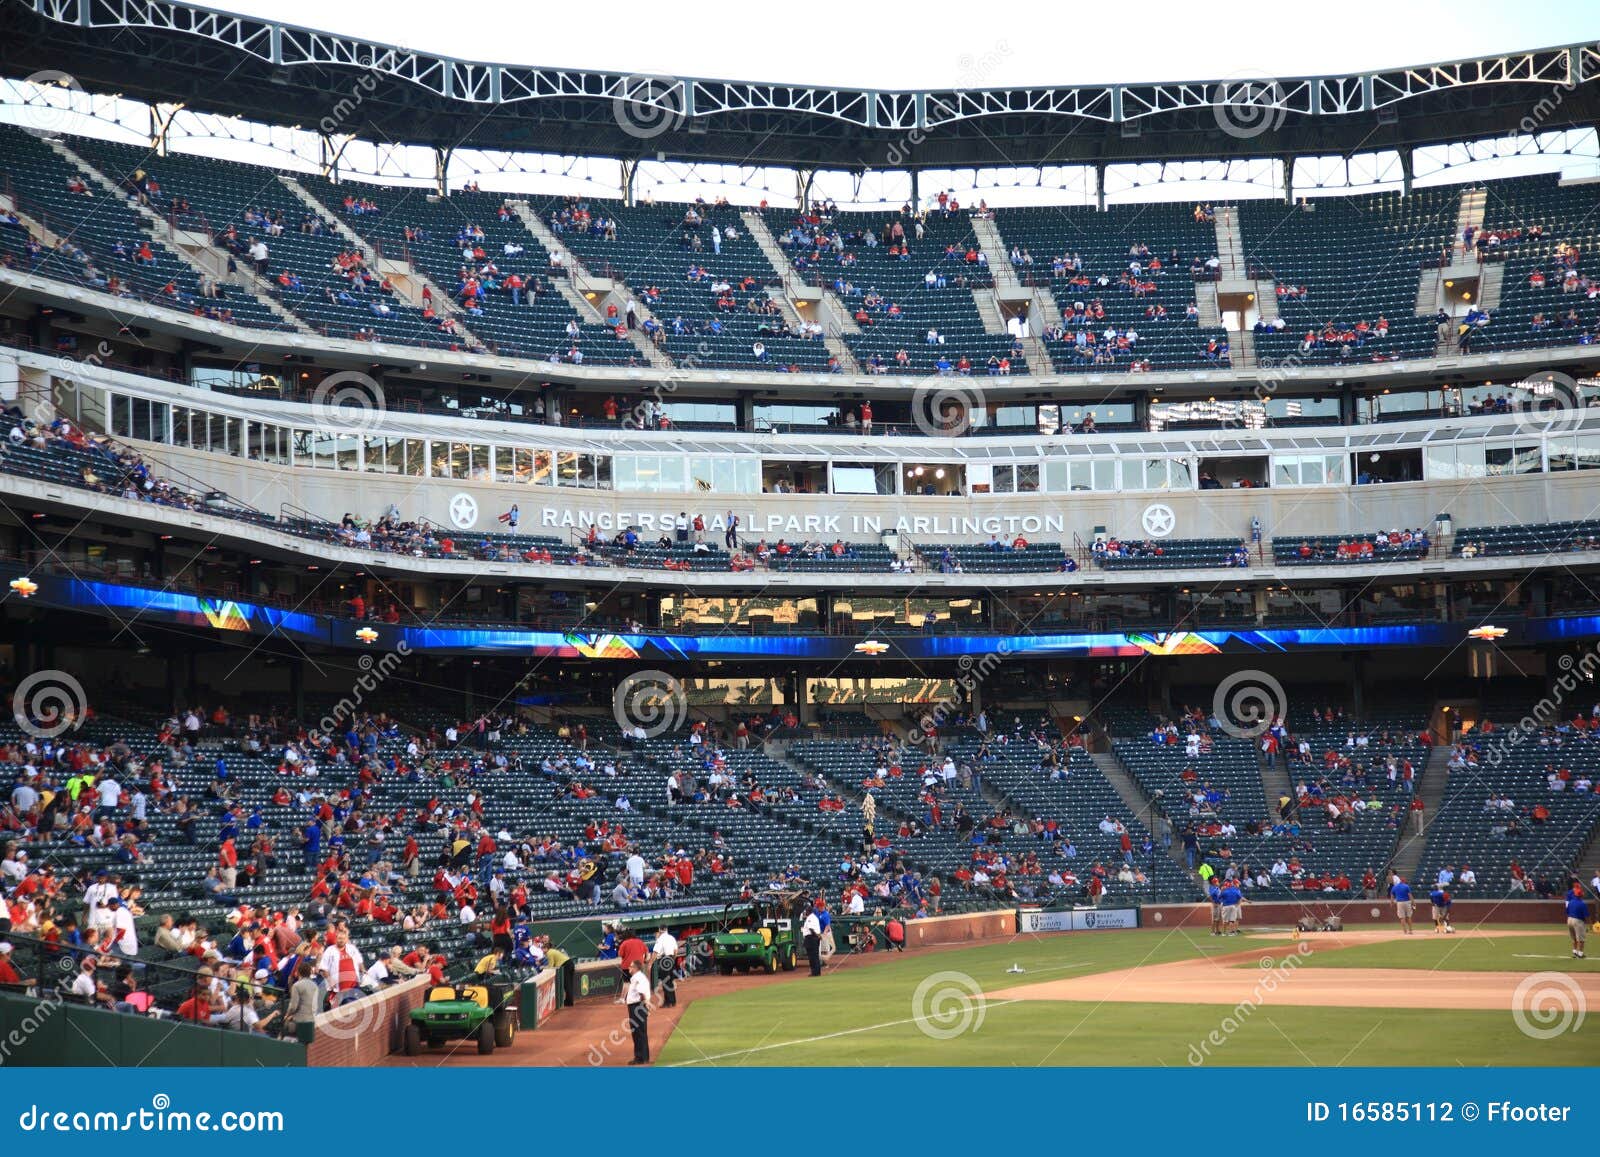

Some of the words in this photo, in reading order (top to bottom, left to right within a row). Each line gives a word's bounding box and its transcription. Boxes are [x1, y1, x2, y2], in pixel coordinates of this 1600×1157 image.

[542, 508, 677, 532] RANGERS
[852, 515, 881, 533] IN
[896, 515, 1064, 534] ARLINGTON
